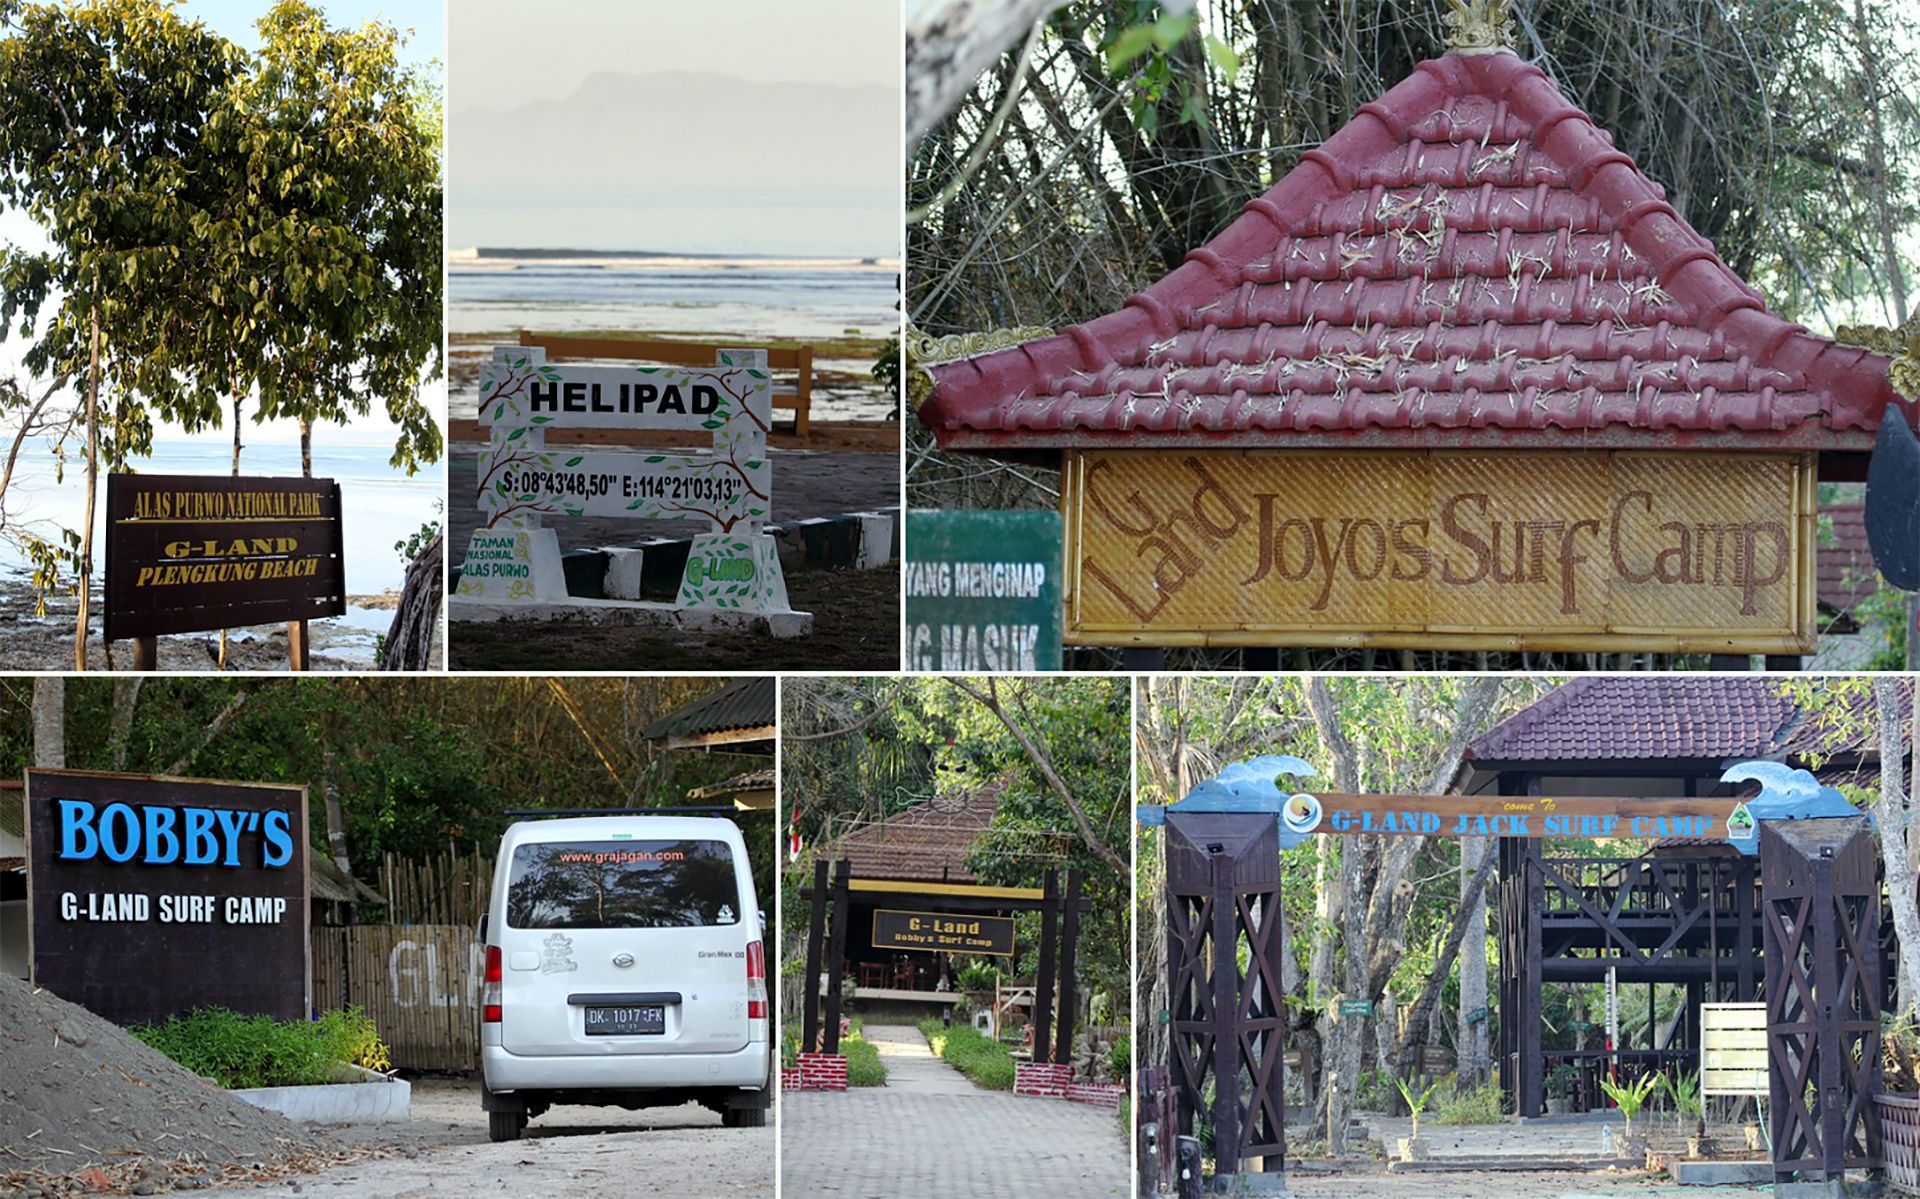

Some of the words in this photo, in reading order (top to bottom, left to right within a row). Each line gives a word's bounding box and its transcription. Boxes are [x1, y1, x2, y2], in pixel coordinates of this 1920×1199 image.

[530, 381, 719, 415] HELIPAD
[134, 491, 171, 518] ALAS
[175, 492, 224, 518] PURWO
[227, 493, 287, 517] NATIONAL
[289, 492, 321, 516] PARK
[164, 537, 298, 558] G-LAND
[466, 550, 514, 560] NASIONAL
[472, 537, 514, 548] TAMAN
[1239, 493, 1432, 612] Joyo's
[1442, 493, 1600, 615] Surf
[1609, 490, 1788, 616] Camp
[136, 561, 256, 587] PLENGKUNG
[259, 558, 319, 580] BEACH
[460, 563, 490, 577] ALAS
[686, 557, 754, 585] G-LAND
[906, 562, 951, 597] YANG
[954, 562, 1045, 598] MENGINAP
[1540, 798, 1556, 811] To
[58, 799, 294, 869] BOBBY'S
[1330, 811, 1441, 834] G-LAND
[1453, 814, 1529, 836] JACK
[1543, 815, 1619, 836] SURF
[1629, 816, 1713, 837] CAMP
[559, 850, 684, 864] www.grajagan.com
[61, 891, 149, 922] G-LAND
[159, 894, 216, 923] SURF
[225, 896, 286, 924] CAMP
[938, 935, 962, 944] Surf
[966, 938, 992, 947] Camp
[613, 1009, 640, 1023] 1017
